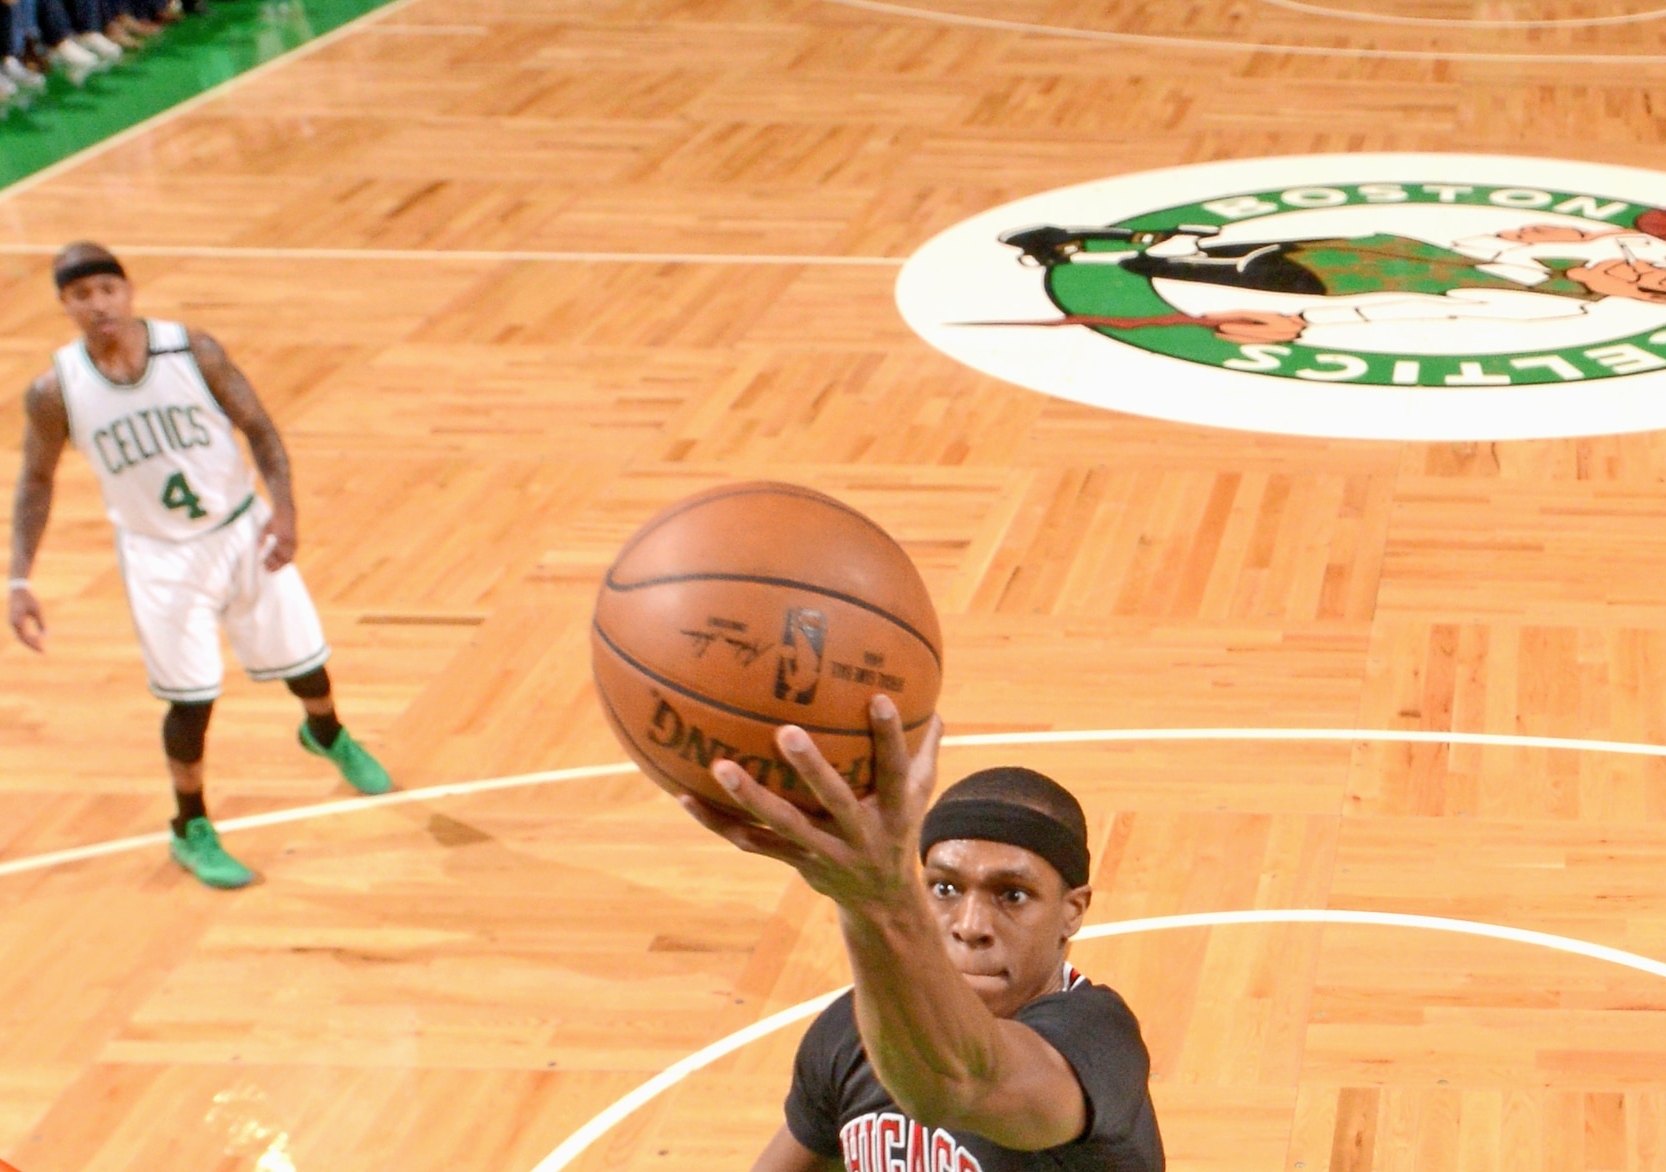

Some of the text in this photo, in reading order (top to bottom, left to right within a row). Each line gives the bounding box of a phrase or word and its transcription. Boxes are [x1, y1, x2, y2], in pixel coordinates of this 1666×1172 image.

[1202, 184, 1631, 220] BOSTON
[93, 404, 211, 475] CELTICS
[161, 471, 208, 519] 4
